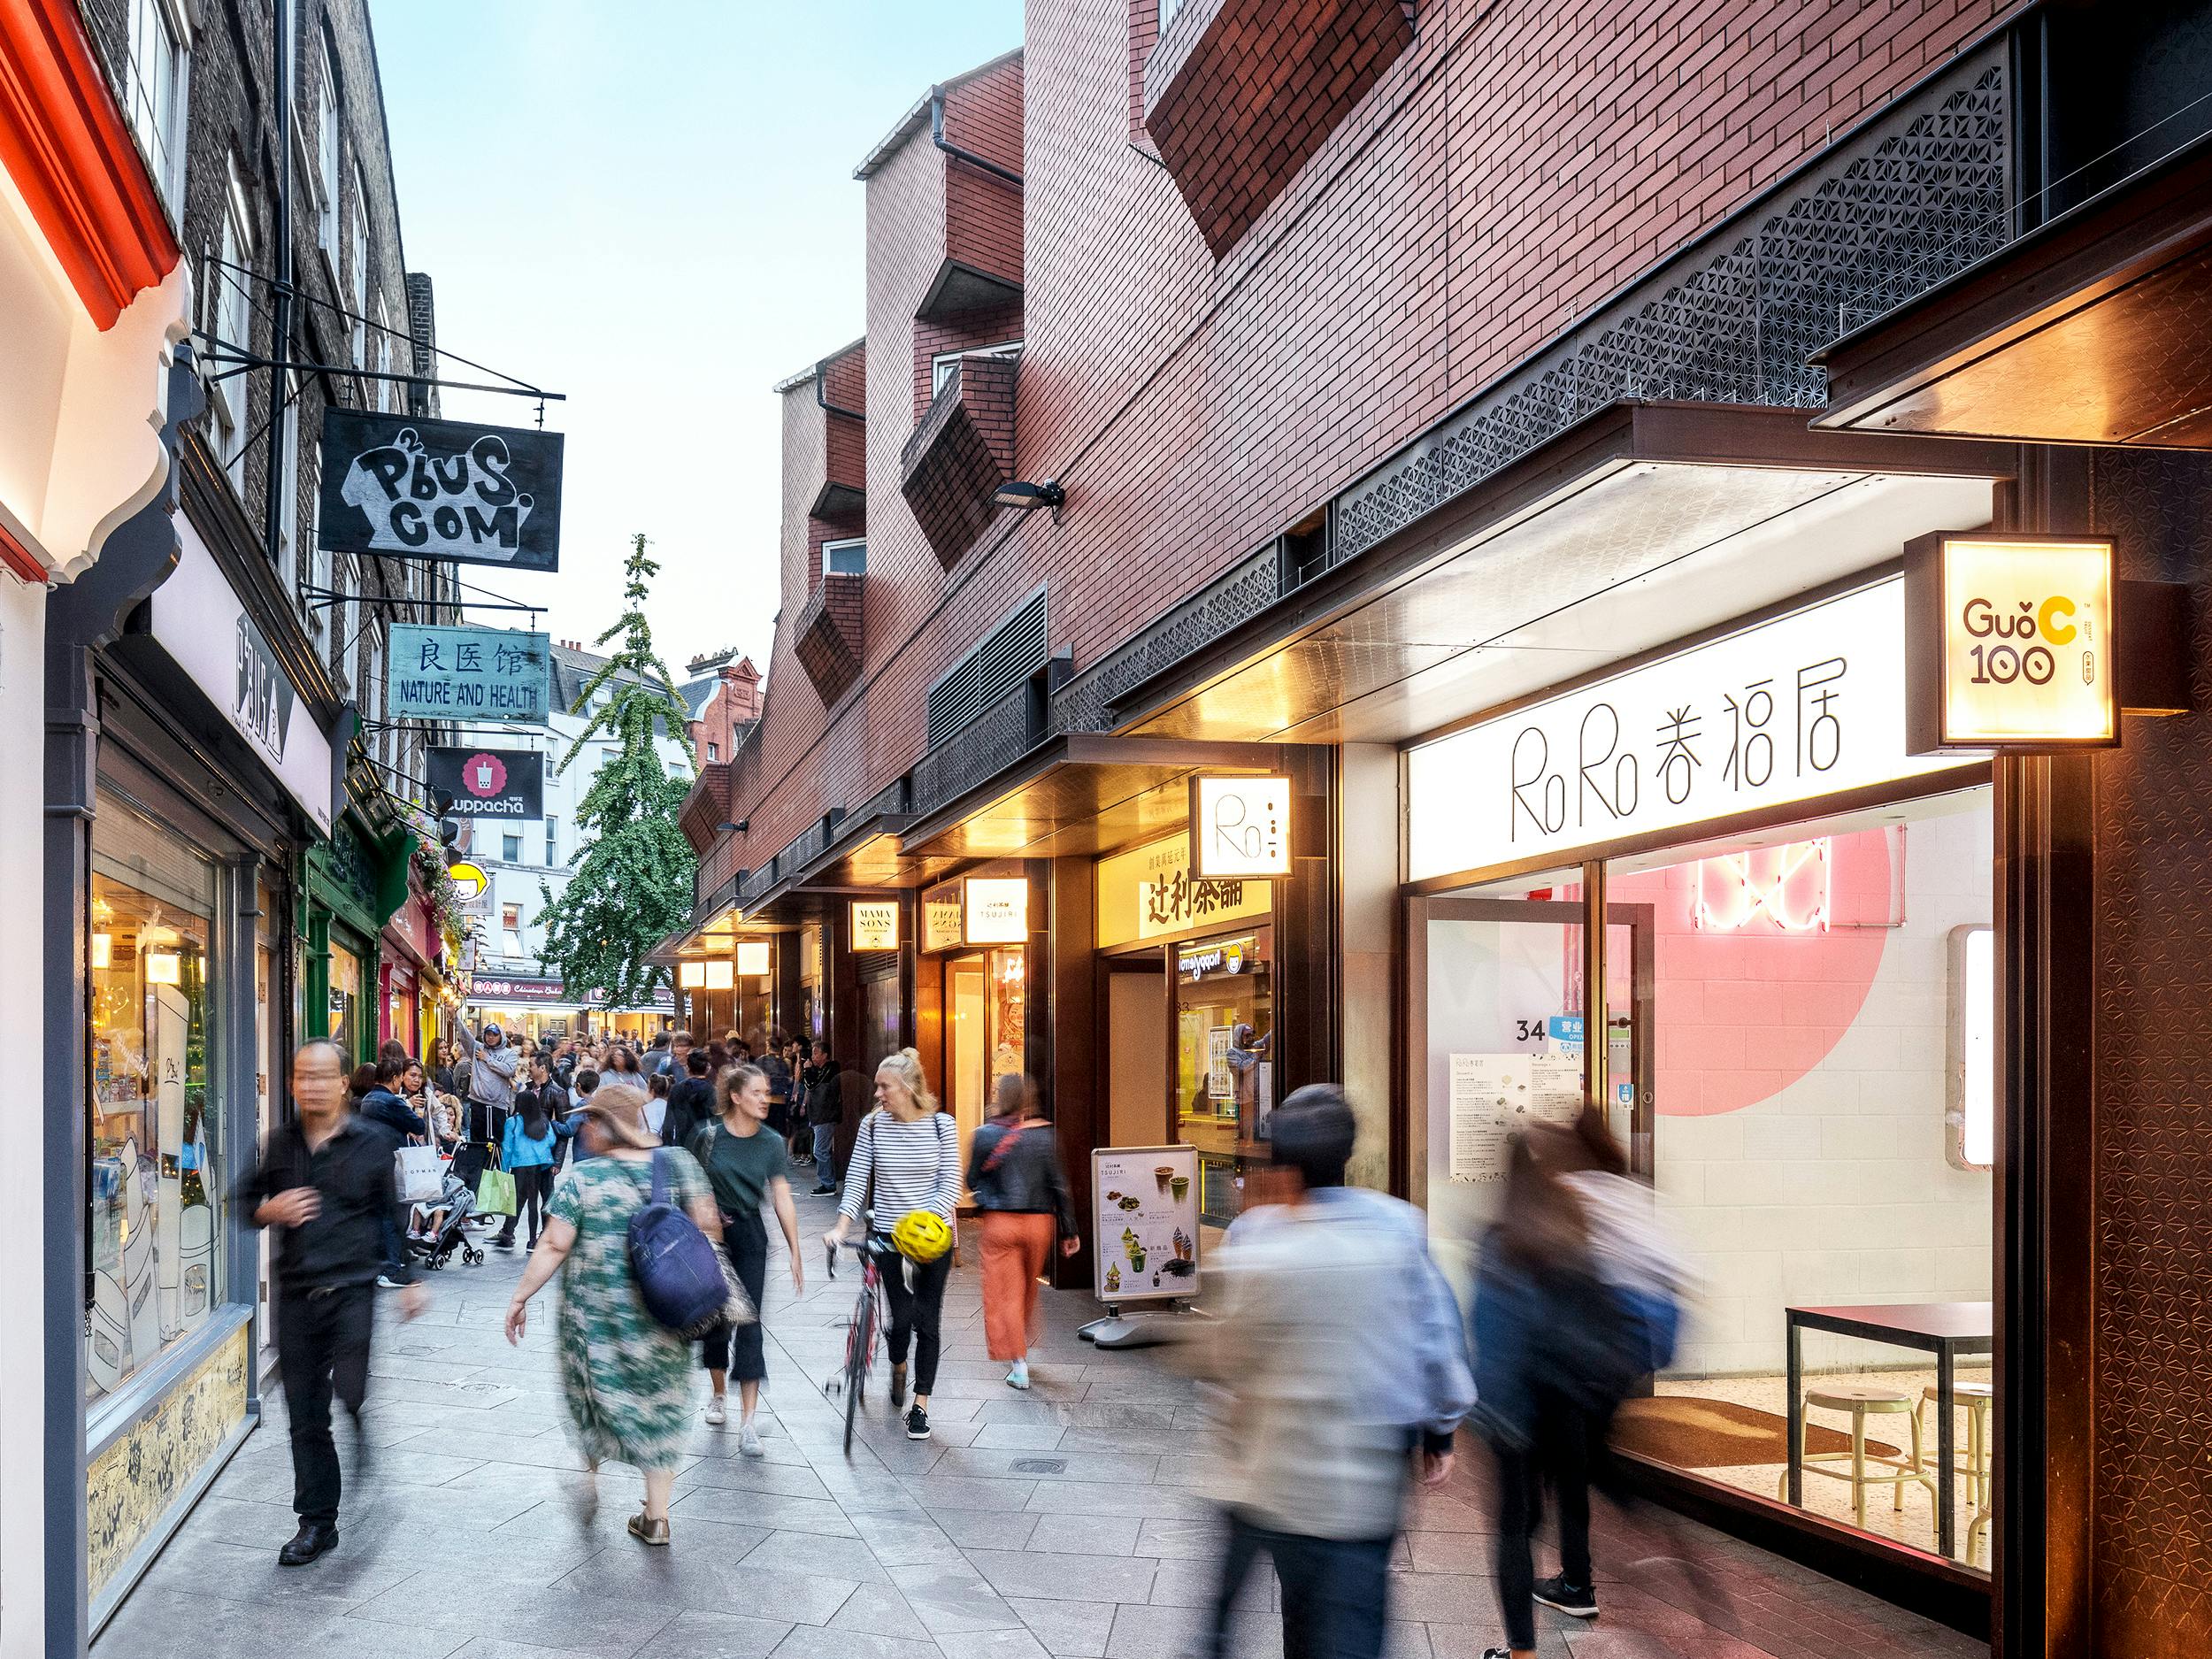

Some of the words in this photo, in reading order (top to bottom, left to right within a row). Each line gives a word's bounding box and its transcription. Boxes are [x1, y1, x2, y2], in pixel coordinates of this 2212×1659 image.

[390, 501, 518, 548] COM
[420, 638, 526, 676] 良医馆
[1970, 644, 2055, 685] 100
[401, 680, 450, 704] NATURE
[457, 682, 484, 707] AND
[490, 684, 538, 709] HEALTH
[449, 799, 524, 813] uppacha
[860, 919, 890, 928] SONS
[1516, 1020, 1545, 1041] 34
